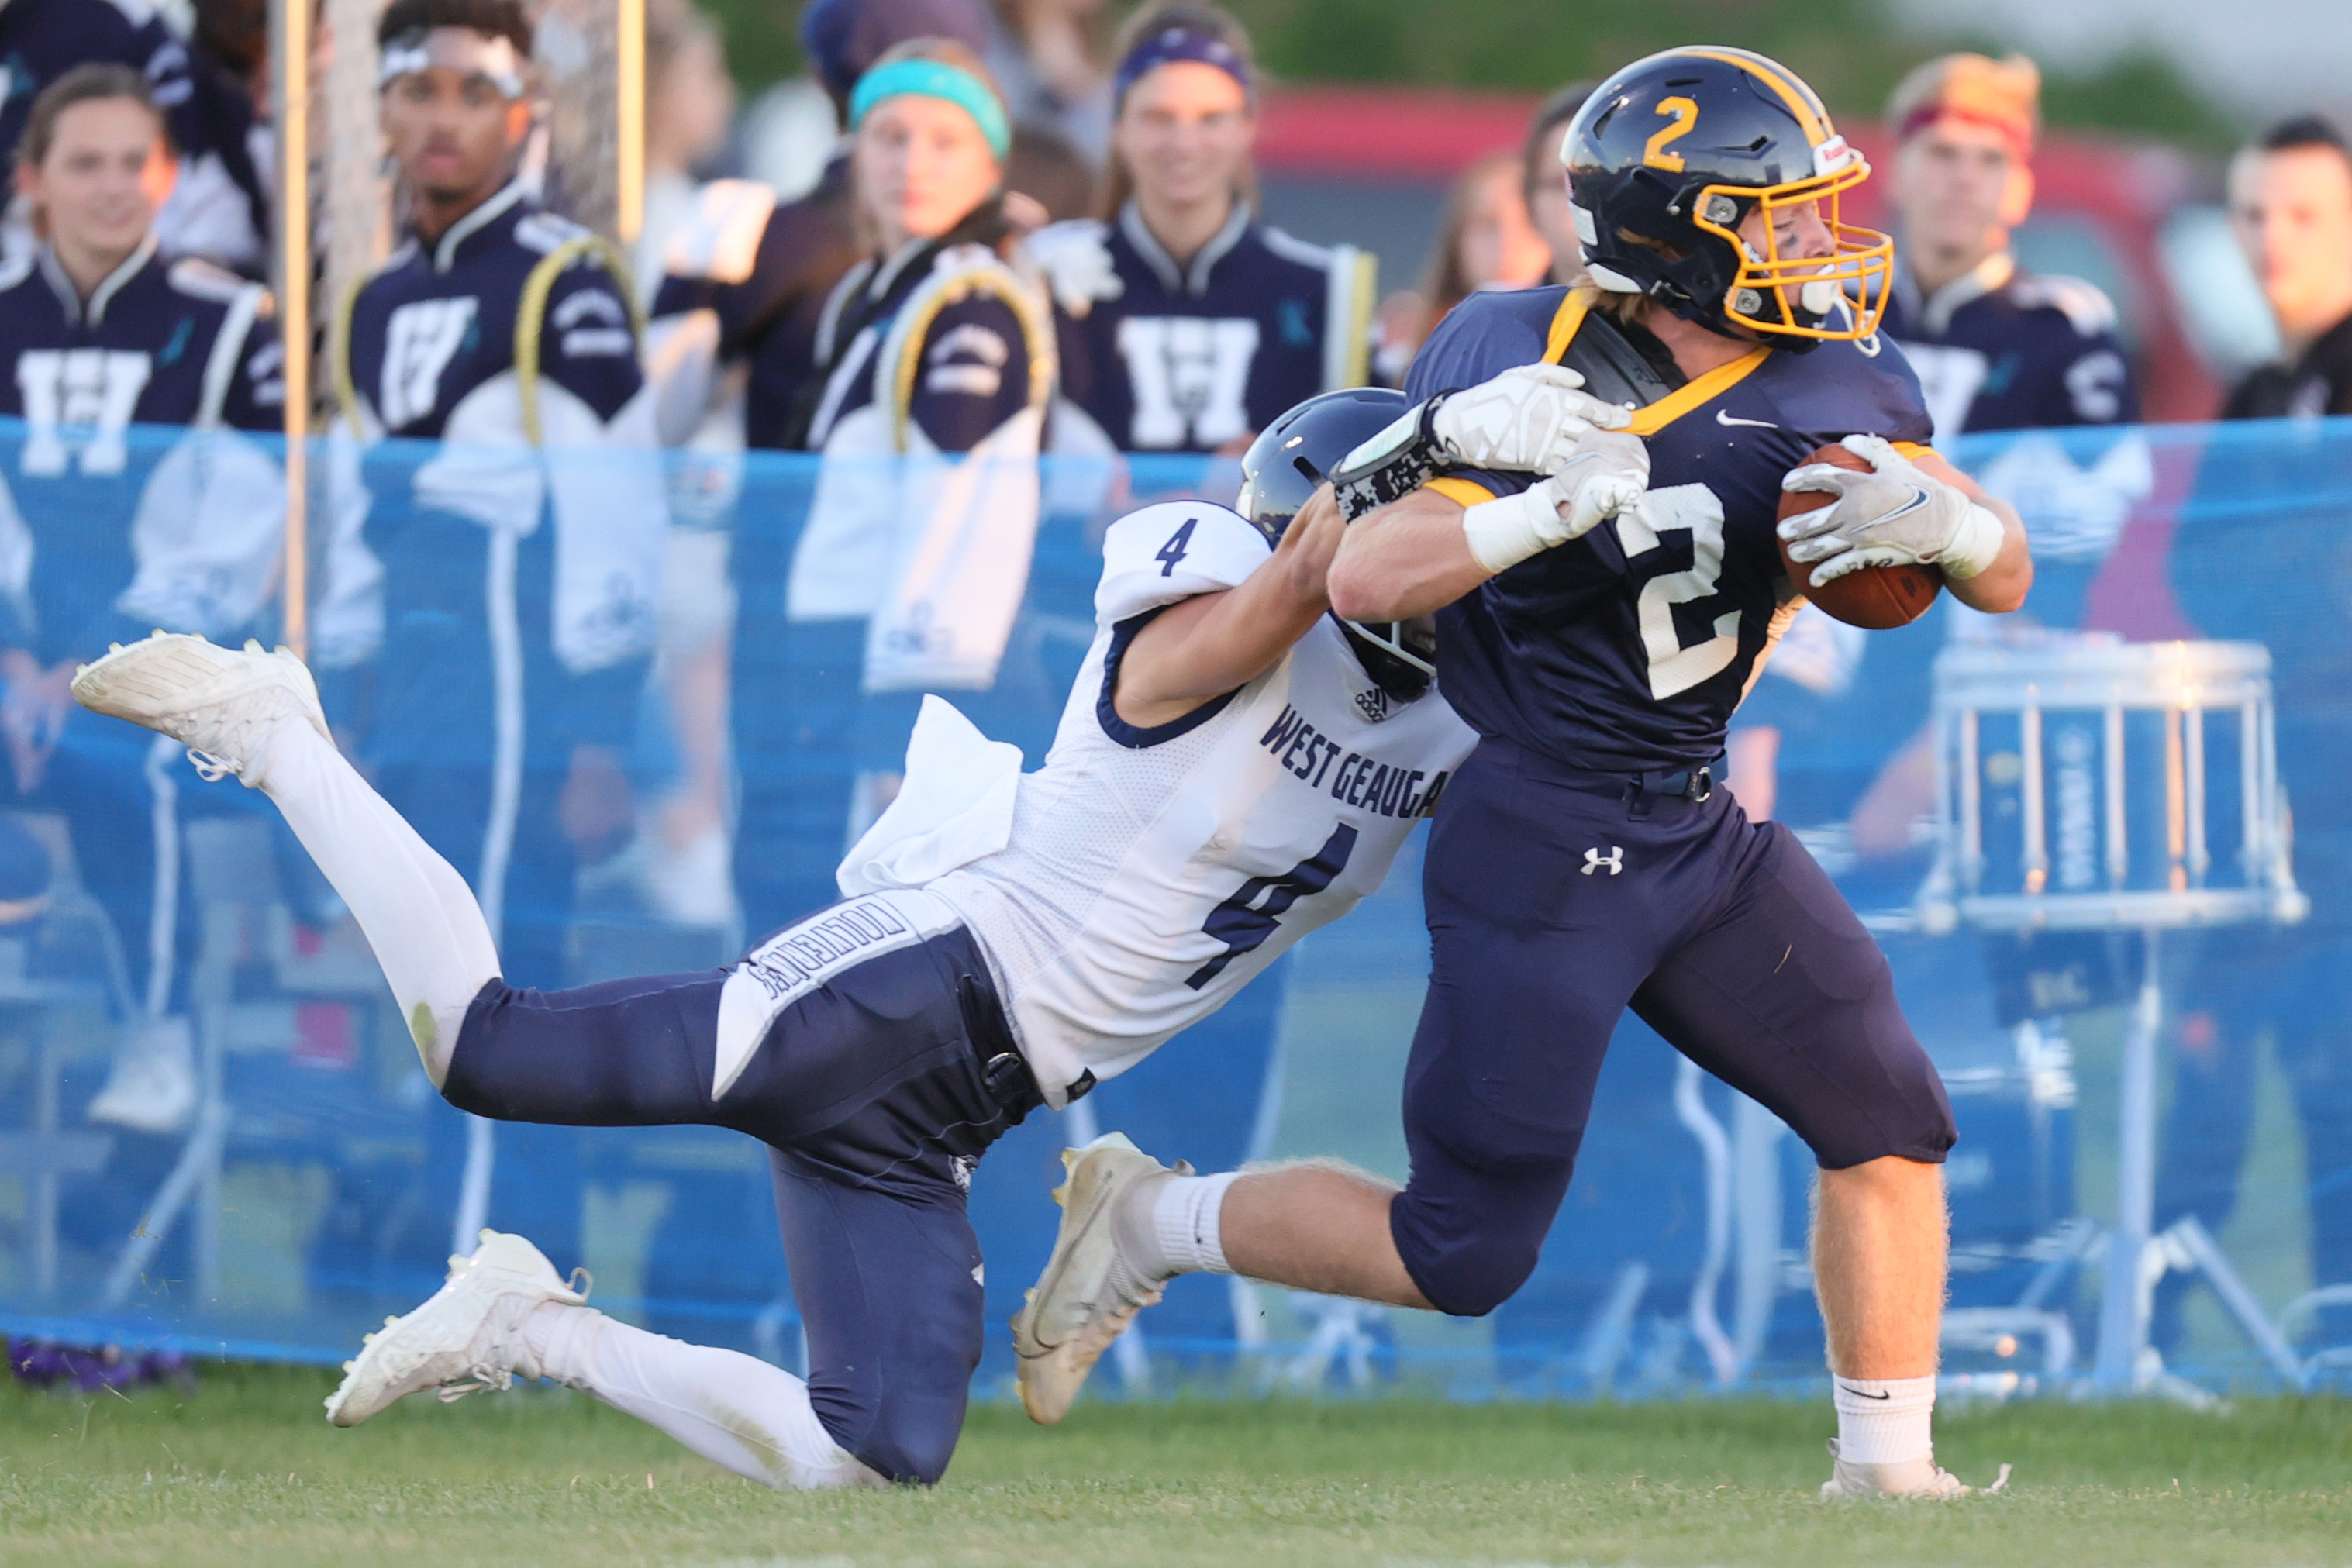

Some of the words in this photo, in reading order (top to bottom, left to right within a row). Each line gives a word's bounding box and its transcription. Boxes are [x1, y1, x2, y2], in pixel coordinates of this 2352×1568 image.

[1642, 96, 1700, 174] 2
[1154, 518, 1198, 577] 4
[1616, 481, 1743, 701] 2
[1259, 702, 1342, 789] WEST
[1330, 753, 1450, 819] GEAUGA
[1183, 822, 1359, 991] 4
